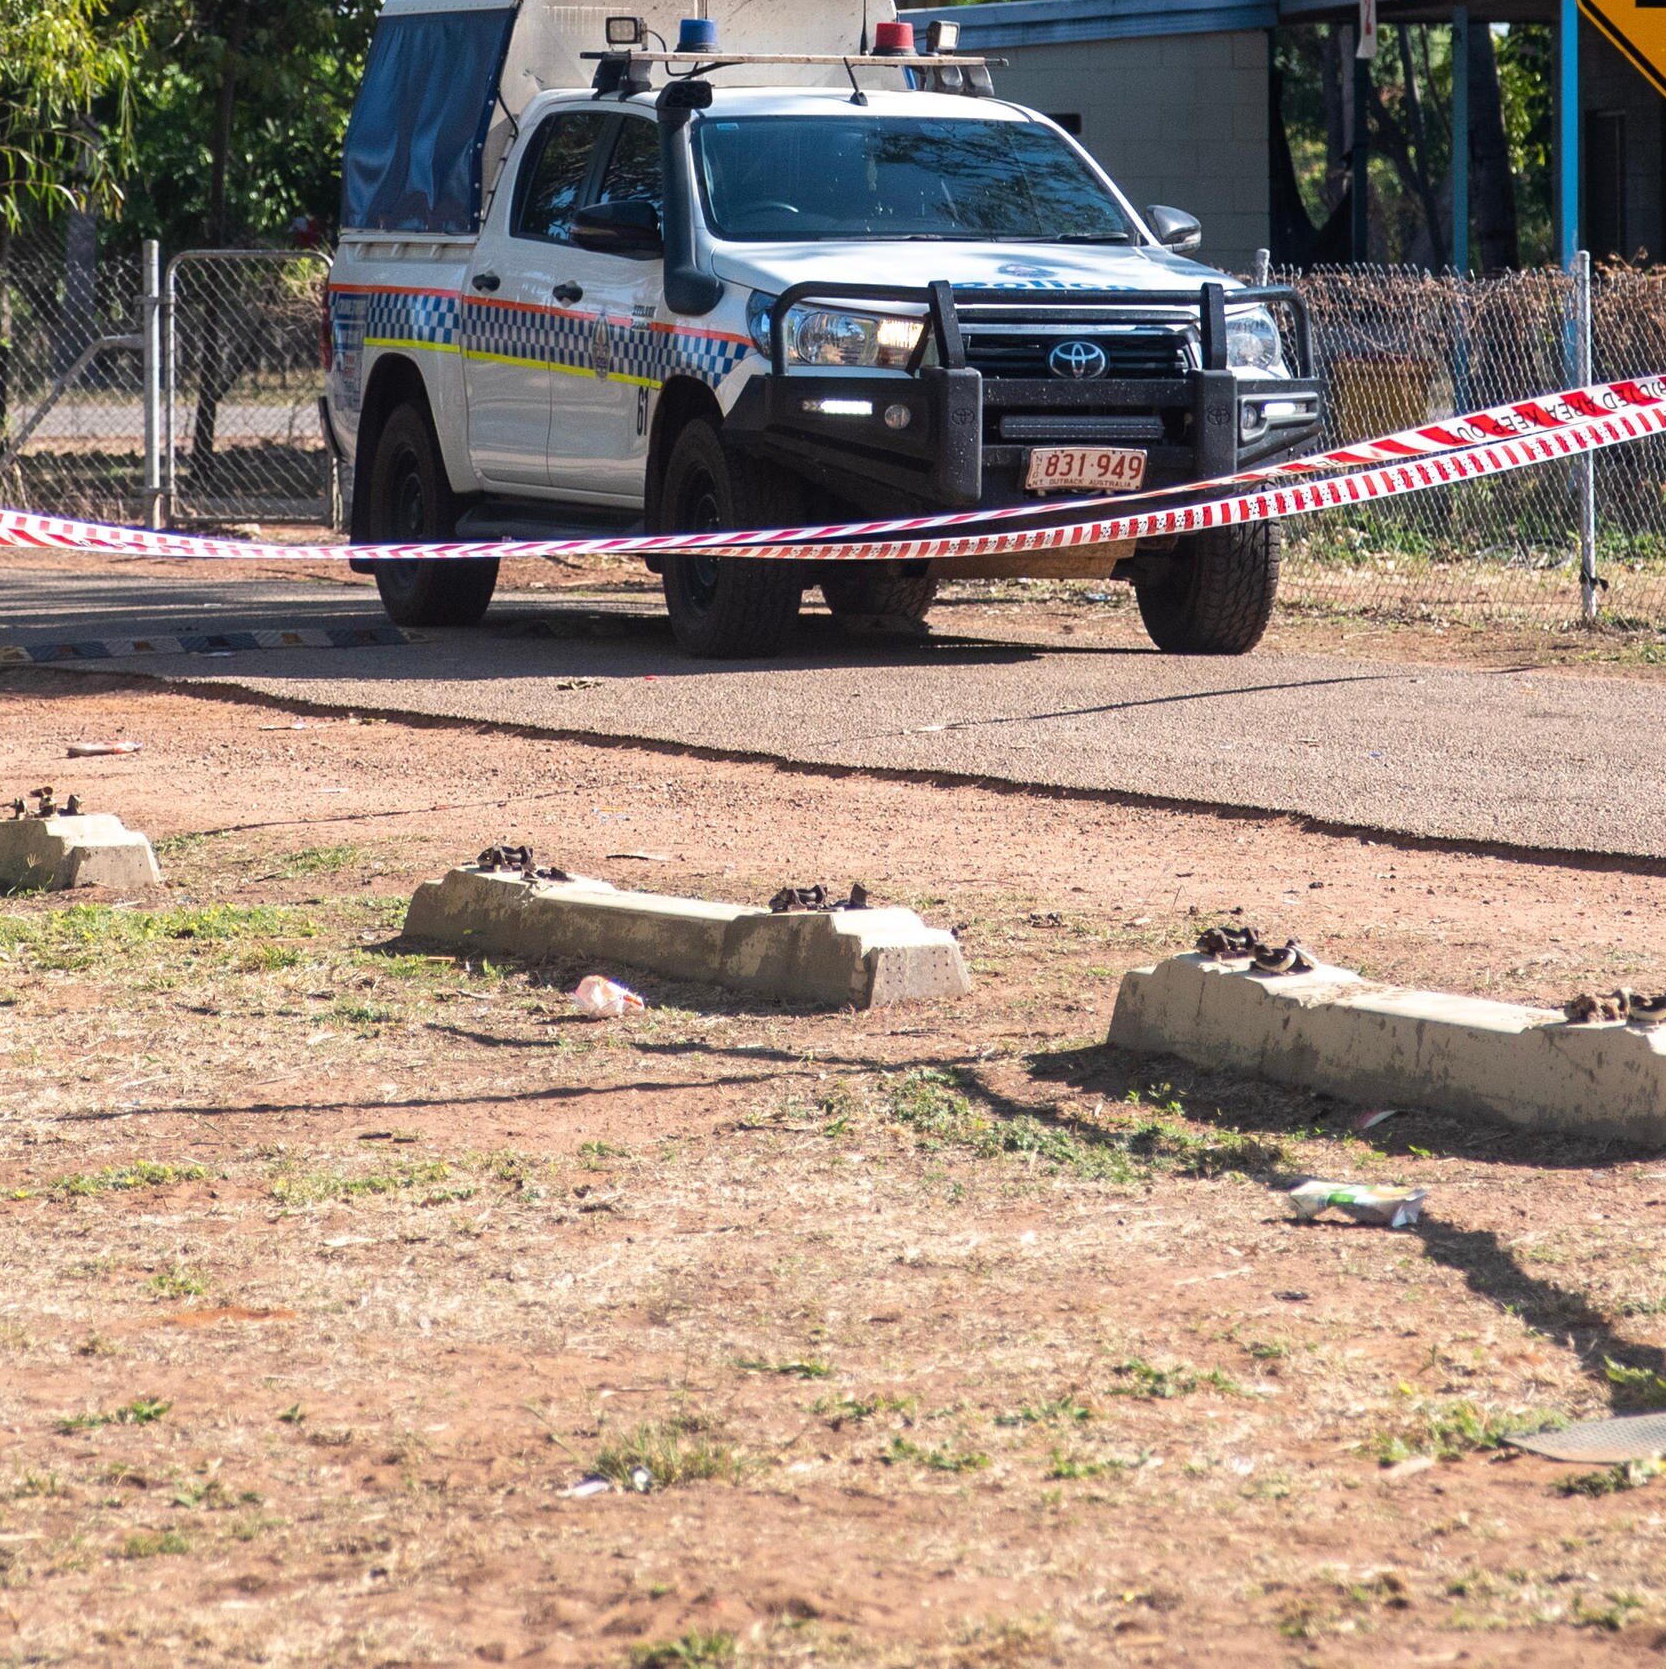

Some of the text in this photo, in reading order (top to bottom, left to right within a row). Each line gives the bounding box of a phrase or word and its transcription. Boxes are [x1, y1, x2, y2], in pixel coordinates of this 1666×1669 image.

[1544, 395, 1596, 421] AREA
[1492, 409, 1541, 434] KEEP
[1446, 423, 1486, 444] OUT
[1088, 479, 1132, 488] AUSTRALIA
